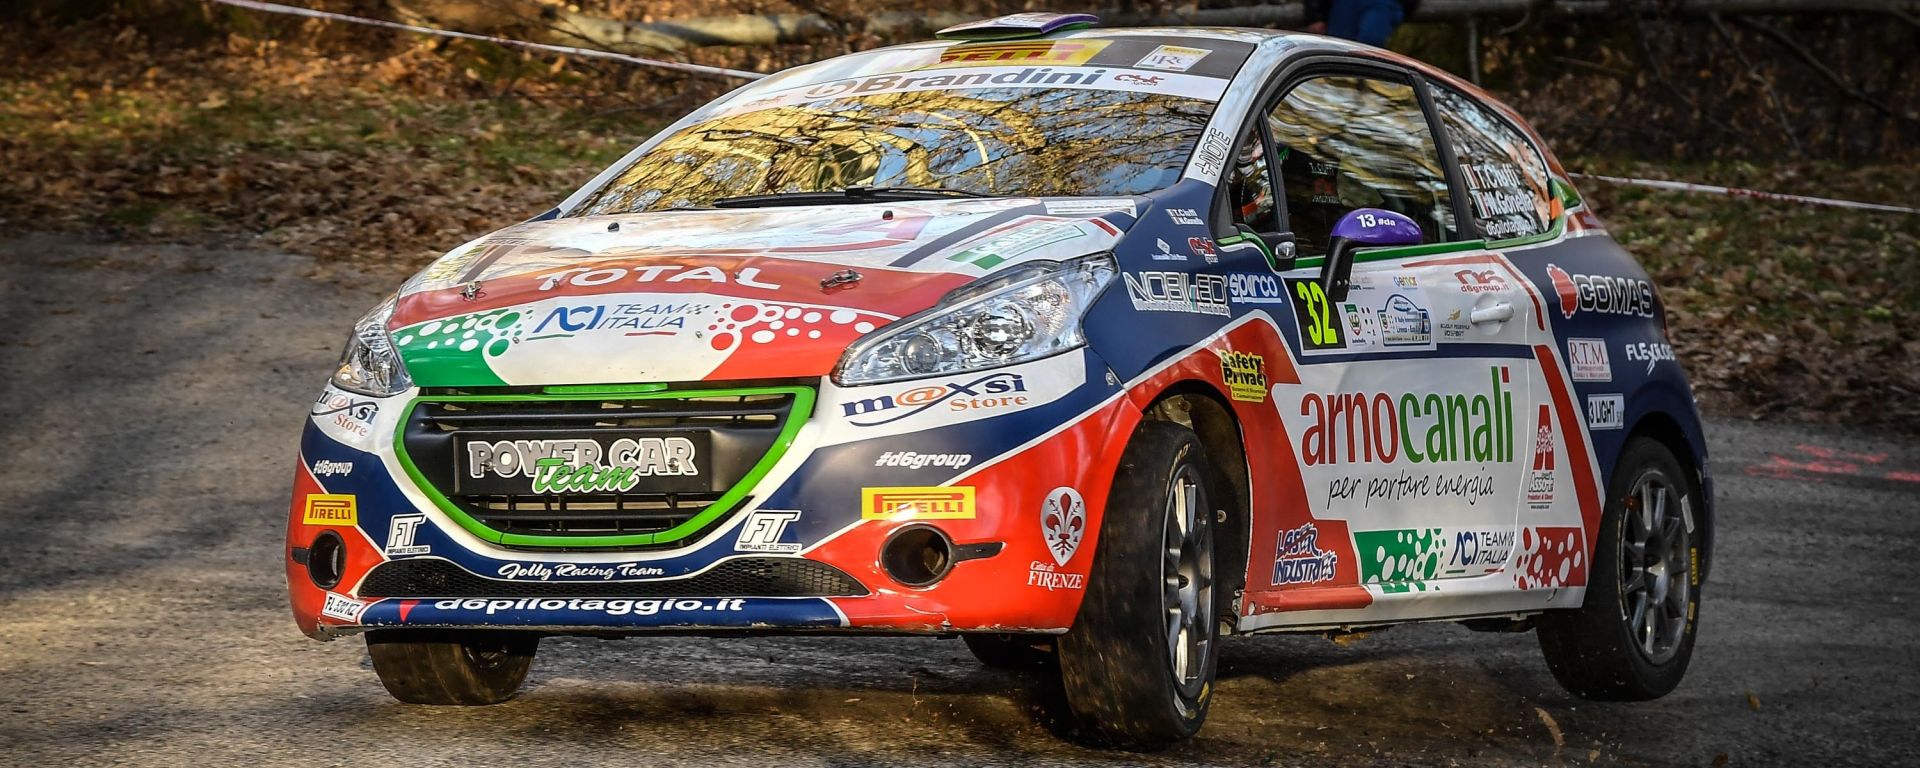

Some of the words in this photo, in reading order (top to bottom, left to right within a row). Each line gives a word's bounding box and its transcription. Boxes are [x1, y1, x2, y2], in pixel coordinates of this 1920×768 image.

[939, 42, 1086, 62] RELLI
[850, 68, 1107, 94] Brandini
[1356, 213, 1376, 228] 13
[1378, 217, 1396, 227] #da
[537, 265, 781, 290] TOTAL
[1229, 273, 1279, 303] sparco
[1461, 285, 1510, 293] d6group.it
[1573, 274, 1654, 318] COMAS
[532, 304, 605, 333] ACI
[611, 303, 687, 316] TEAM
[598, 316, 685, 330] ITALIA
[1296, 280, 1339, 346] 32
[1222, 351, 1263, 372] Safety
[1569, 342, 1609, 365] R.T.M.
[1223, 368, 1268, 389] Privacy
[840, 373, 1028, 427] m@xsi
[949, 392, 1028, 412] Store
[1301, 366, 1514, 467] arnocanali
[1589, 400, 1595, 424] 3
[1595, 400, 1616, 424] LIGHT
[334, 413, 368, 436] Store
[313, 460, 353, 477] #d6group
[468, 439, 602, 478] POWER
[609, 438, 698, 475] CAR
[875, 451, 972, 470] #d6group
[532, 457, 639, 494] Team
[1327, 475, 1361, 511] per
[1365, 468, 1430, 508] portare
[1436, 466, 1494, 506] energia
[309, 500, 351, 519] PIRELLI
[739, 511, 799, 543] FT
[1277, 522, 1322, 557] LASER
[1450, 530, 1478, 566] ACI
[1480, 531, 1507, 547] TEAM
[1475, 549, 1509, 564] ITALIA
[498, 562, 552, 581] Jolly
[554, 563, 613, 580] Racing
[616, 563, 665, 577] Team
[1027, 570, 1084, 591] FIRENZE
[434, 598, 747, 615] d6pilotaggio.it
